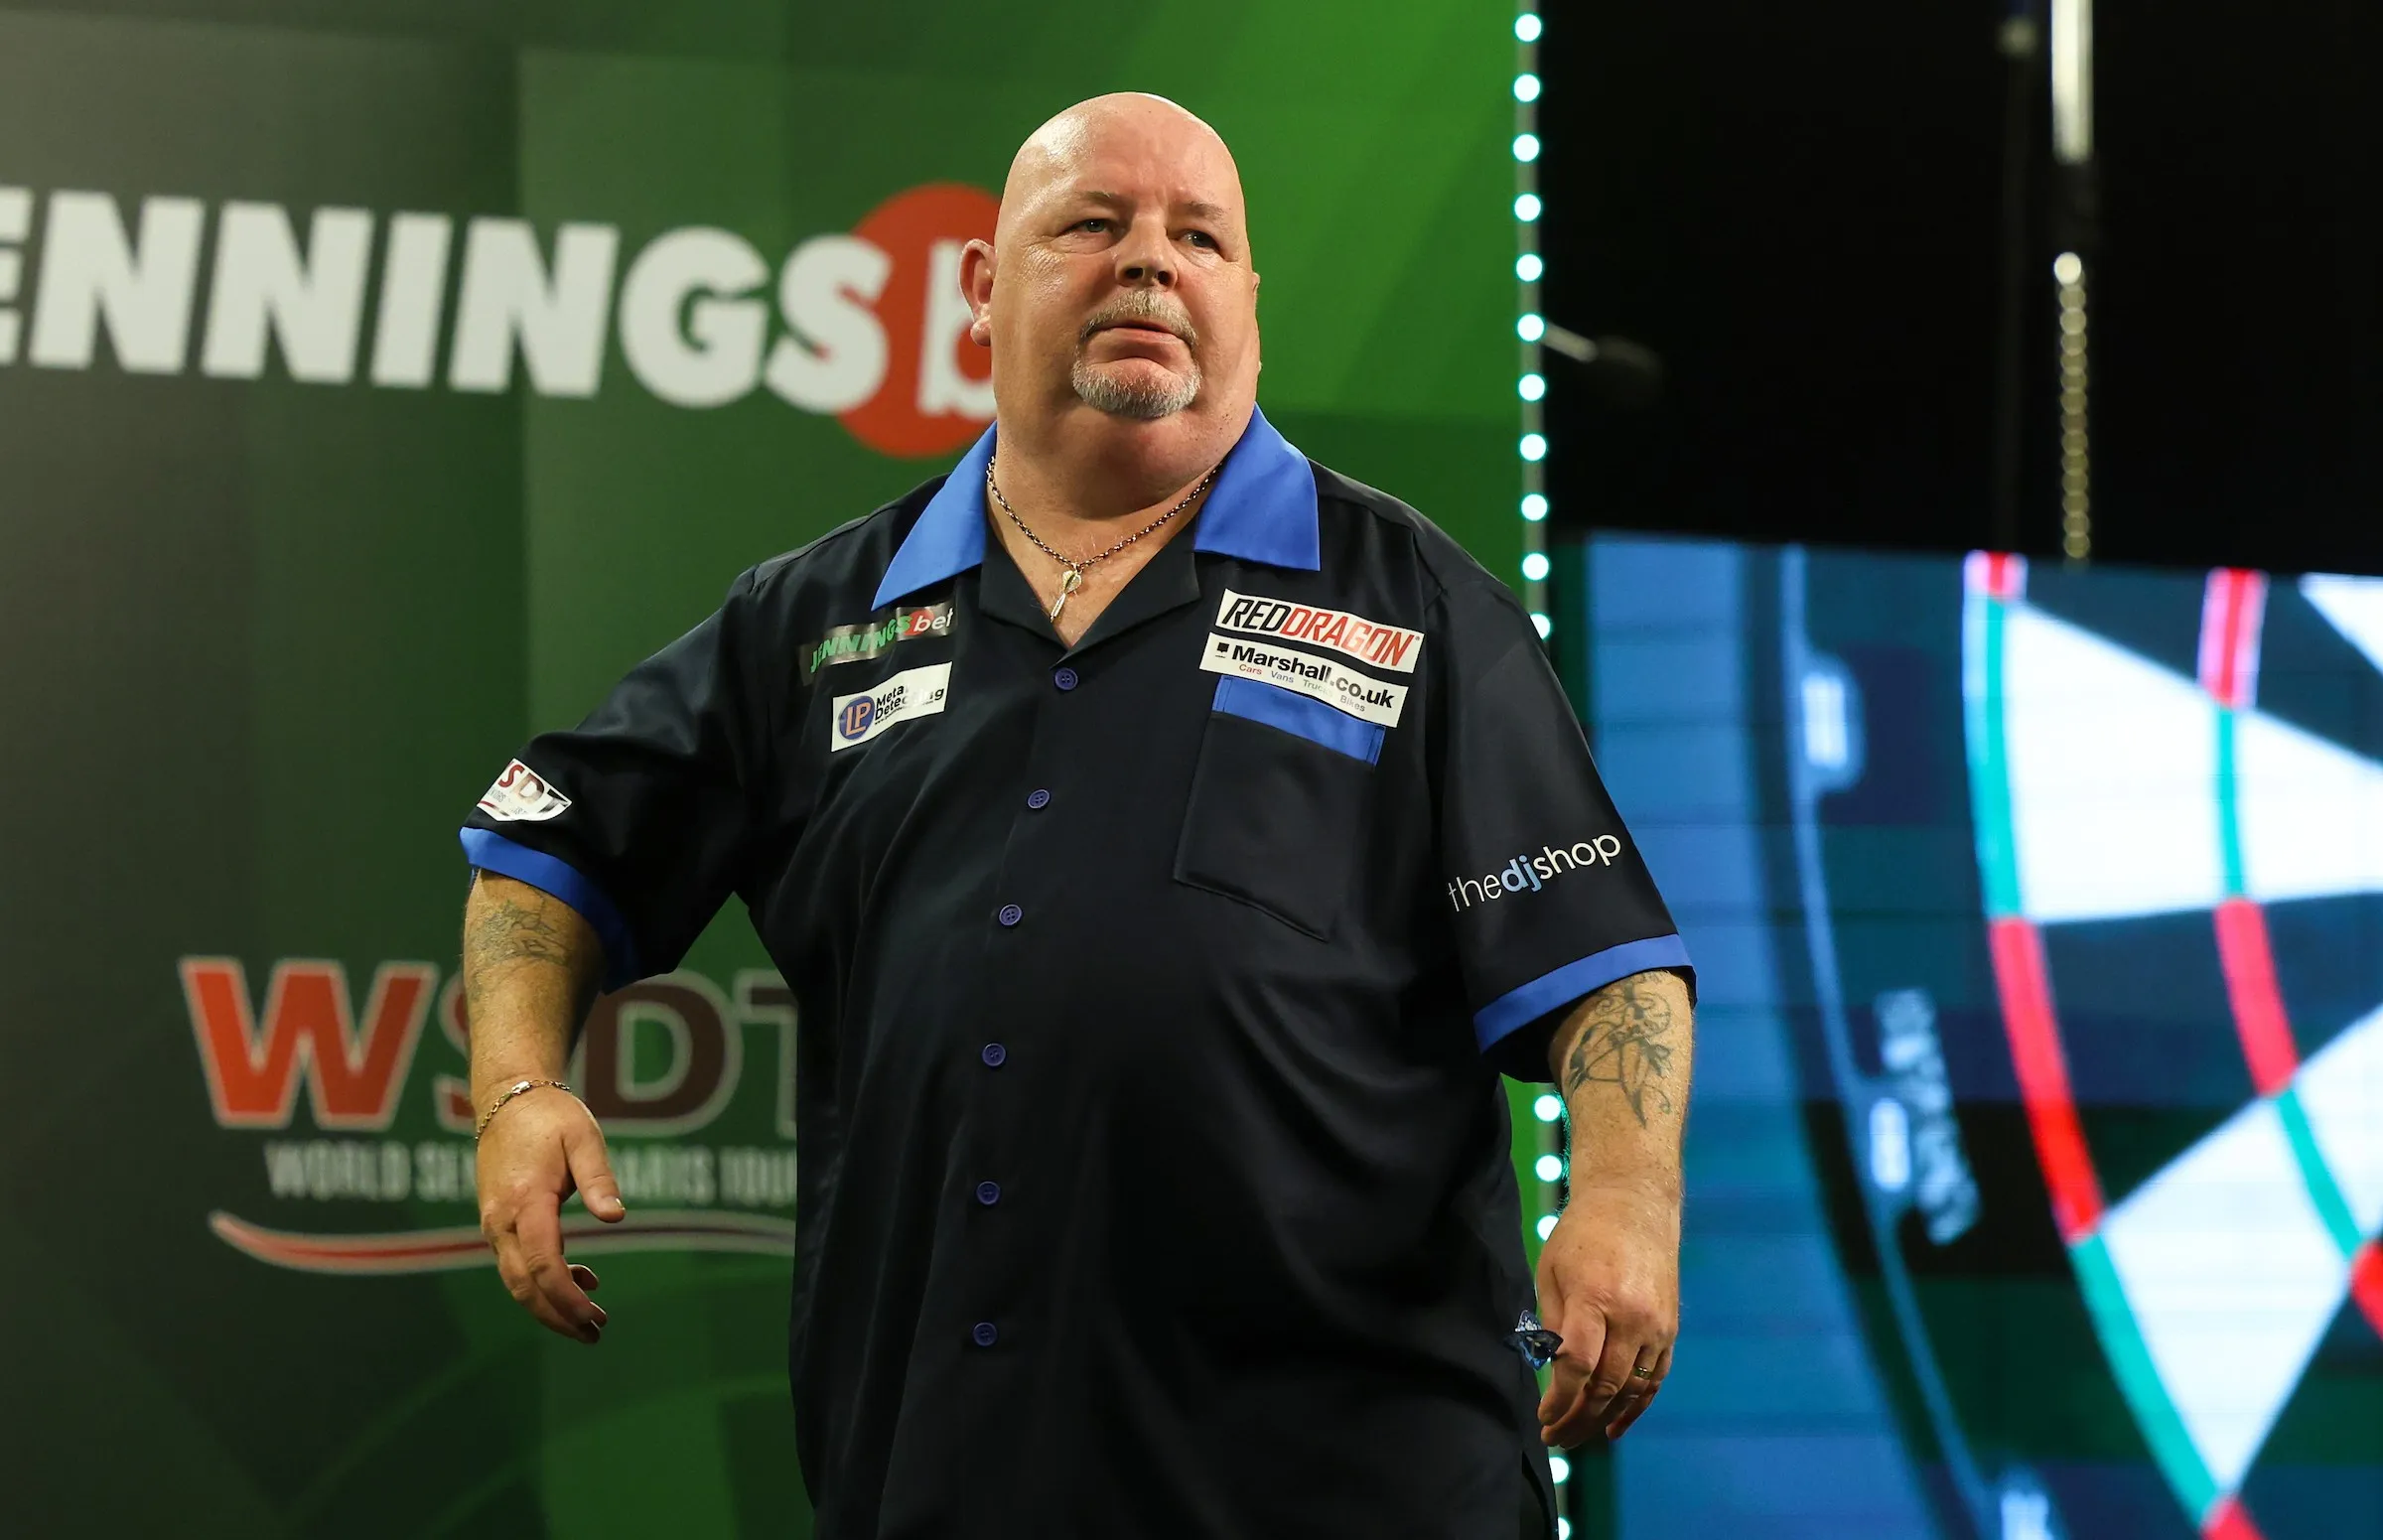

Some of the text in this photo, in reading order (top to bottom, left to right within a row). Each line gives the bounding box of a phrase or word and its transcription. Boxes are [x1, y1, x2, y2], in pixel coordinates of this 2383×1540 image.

[1222, 598, 1415, 666] REDDRAGON
[1232, 645, 1395, 708] Marshall.co.uk
[1239, 663, 1262, 675] Cars
[1271, 671, 1294, 683] Vans
[1304, 679, 1332, 696] Truc
[1448, 834, 1621, 911] thedjshop
